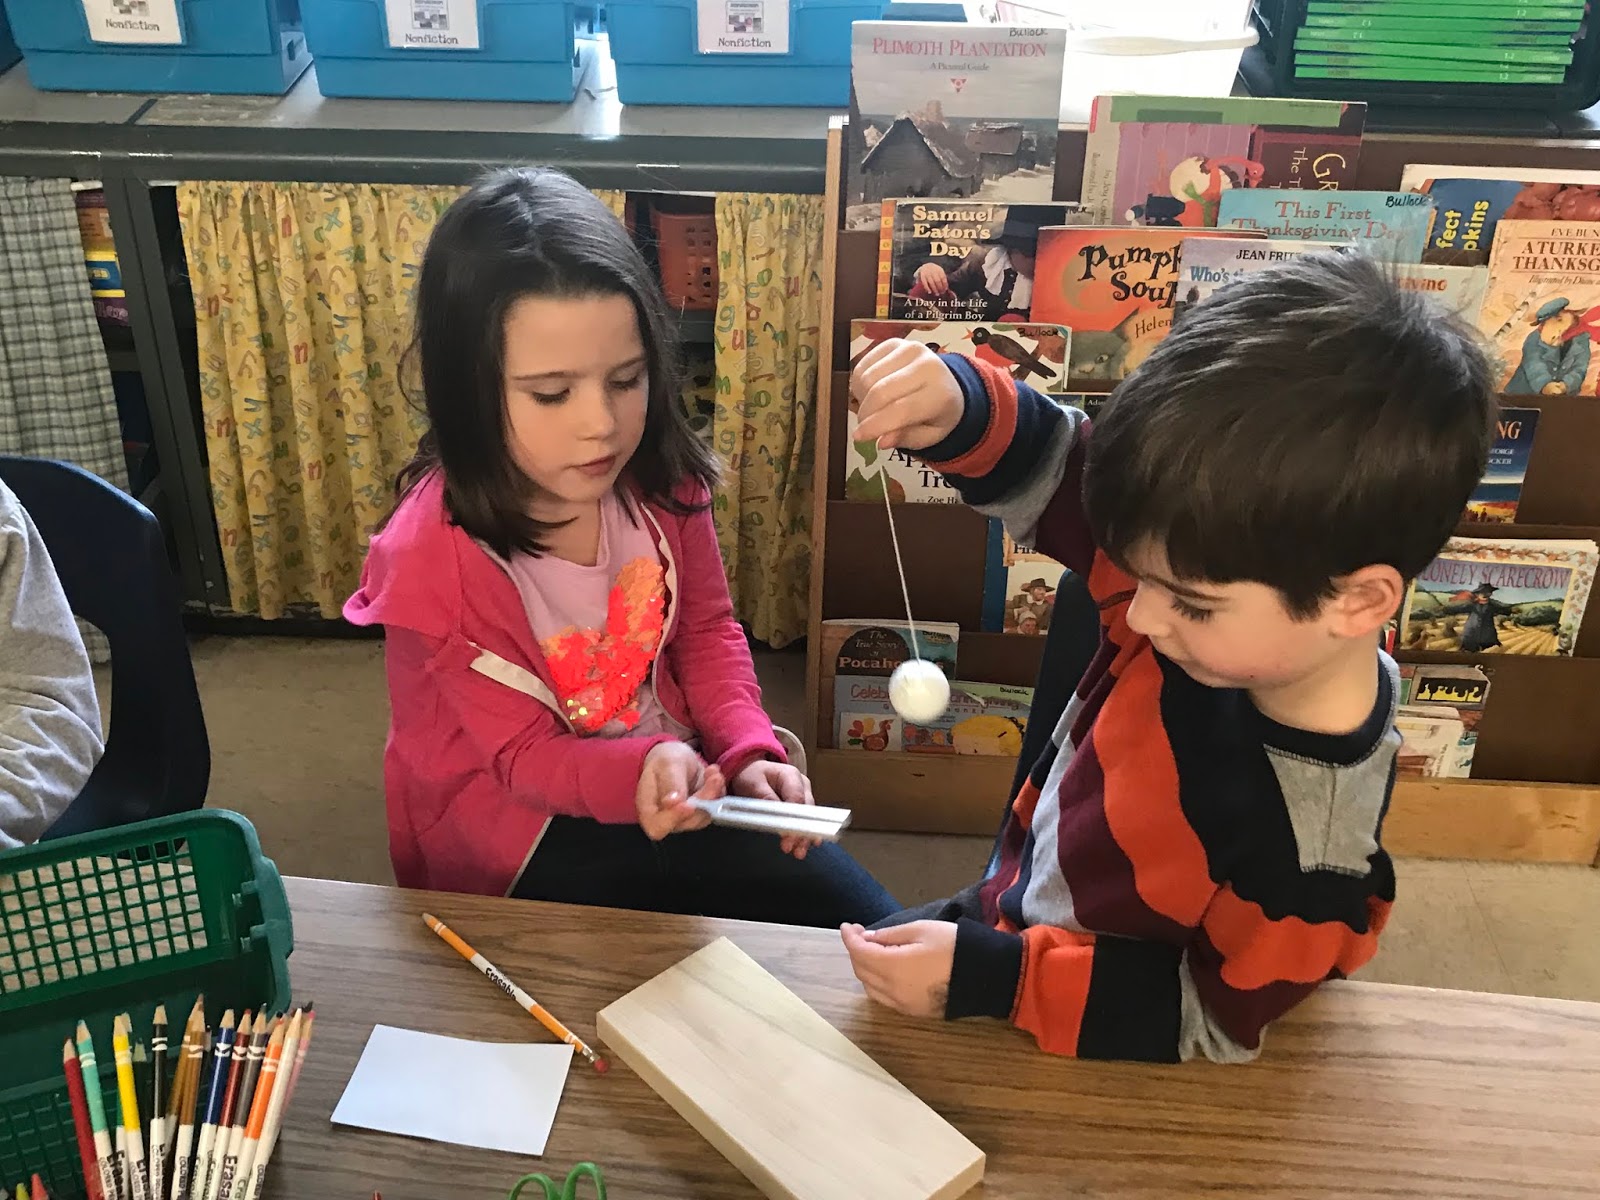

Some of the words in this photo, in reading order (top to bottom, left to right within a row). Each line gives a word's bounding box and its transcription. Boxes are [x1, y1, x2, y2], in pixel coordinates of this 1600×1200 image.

[105, 18, 160, 32] Nonfiction
[405, 33, 459, 45] Nonfiction
[1009, 28, 1048, 37] Bullock
[718, 37, 772, 48] Nonfiction
[873, 38, 943, 56] PLIMOTH
[949, 39, 1048, 57] PLANTATION
[968, 63, 990, 71] Guide
[1290, 147, 1308, 174] The
[1385, 195, 1428, 208] Bullock
[912, 205, 994, 221] Samuel
[1275, 201, 1320, 218] This
[1324, 202, 1371, 220] First
[912, 223, 991, 239] Eaton's
[929, 241, 972, 259] Day
[1521, 241, 1533, 254] A
[1236, 249, 1266, 260] JEAN
[1190, 265, 1230, 282] Who's
[904, 299, 912, 307] A
[915, 299, 936, 309] Day
[938, 298, 948, 307] in
[950, 298, 967, 308] the
[969, 298, 988, 308] Life
[905, 310, 916, 319] of
[926, 310, 963, 322] Pilgrim
[965, 311, 985, 322] Boy
[1135, 316, 1173, 339] Helen
[1481, 565, 1572, 590] SCARECROW
[869, 630, 887, 639] The
[855, 639, 872, 648] True
